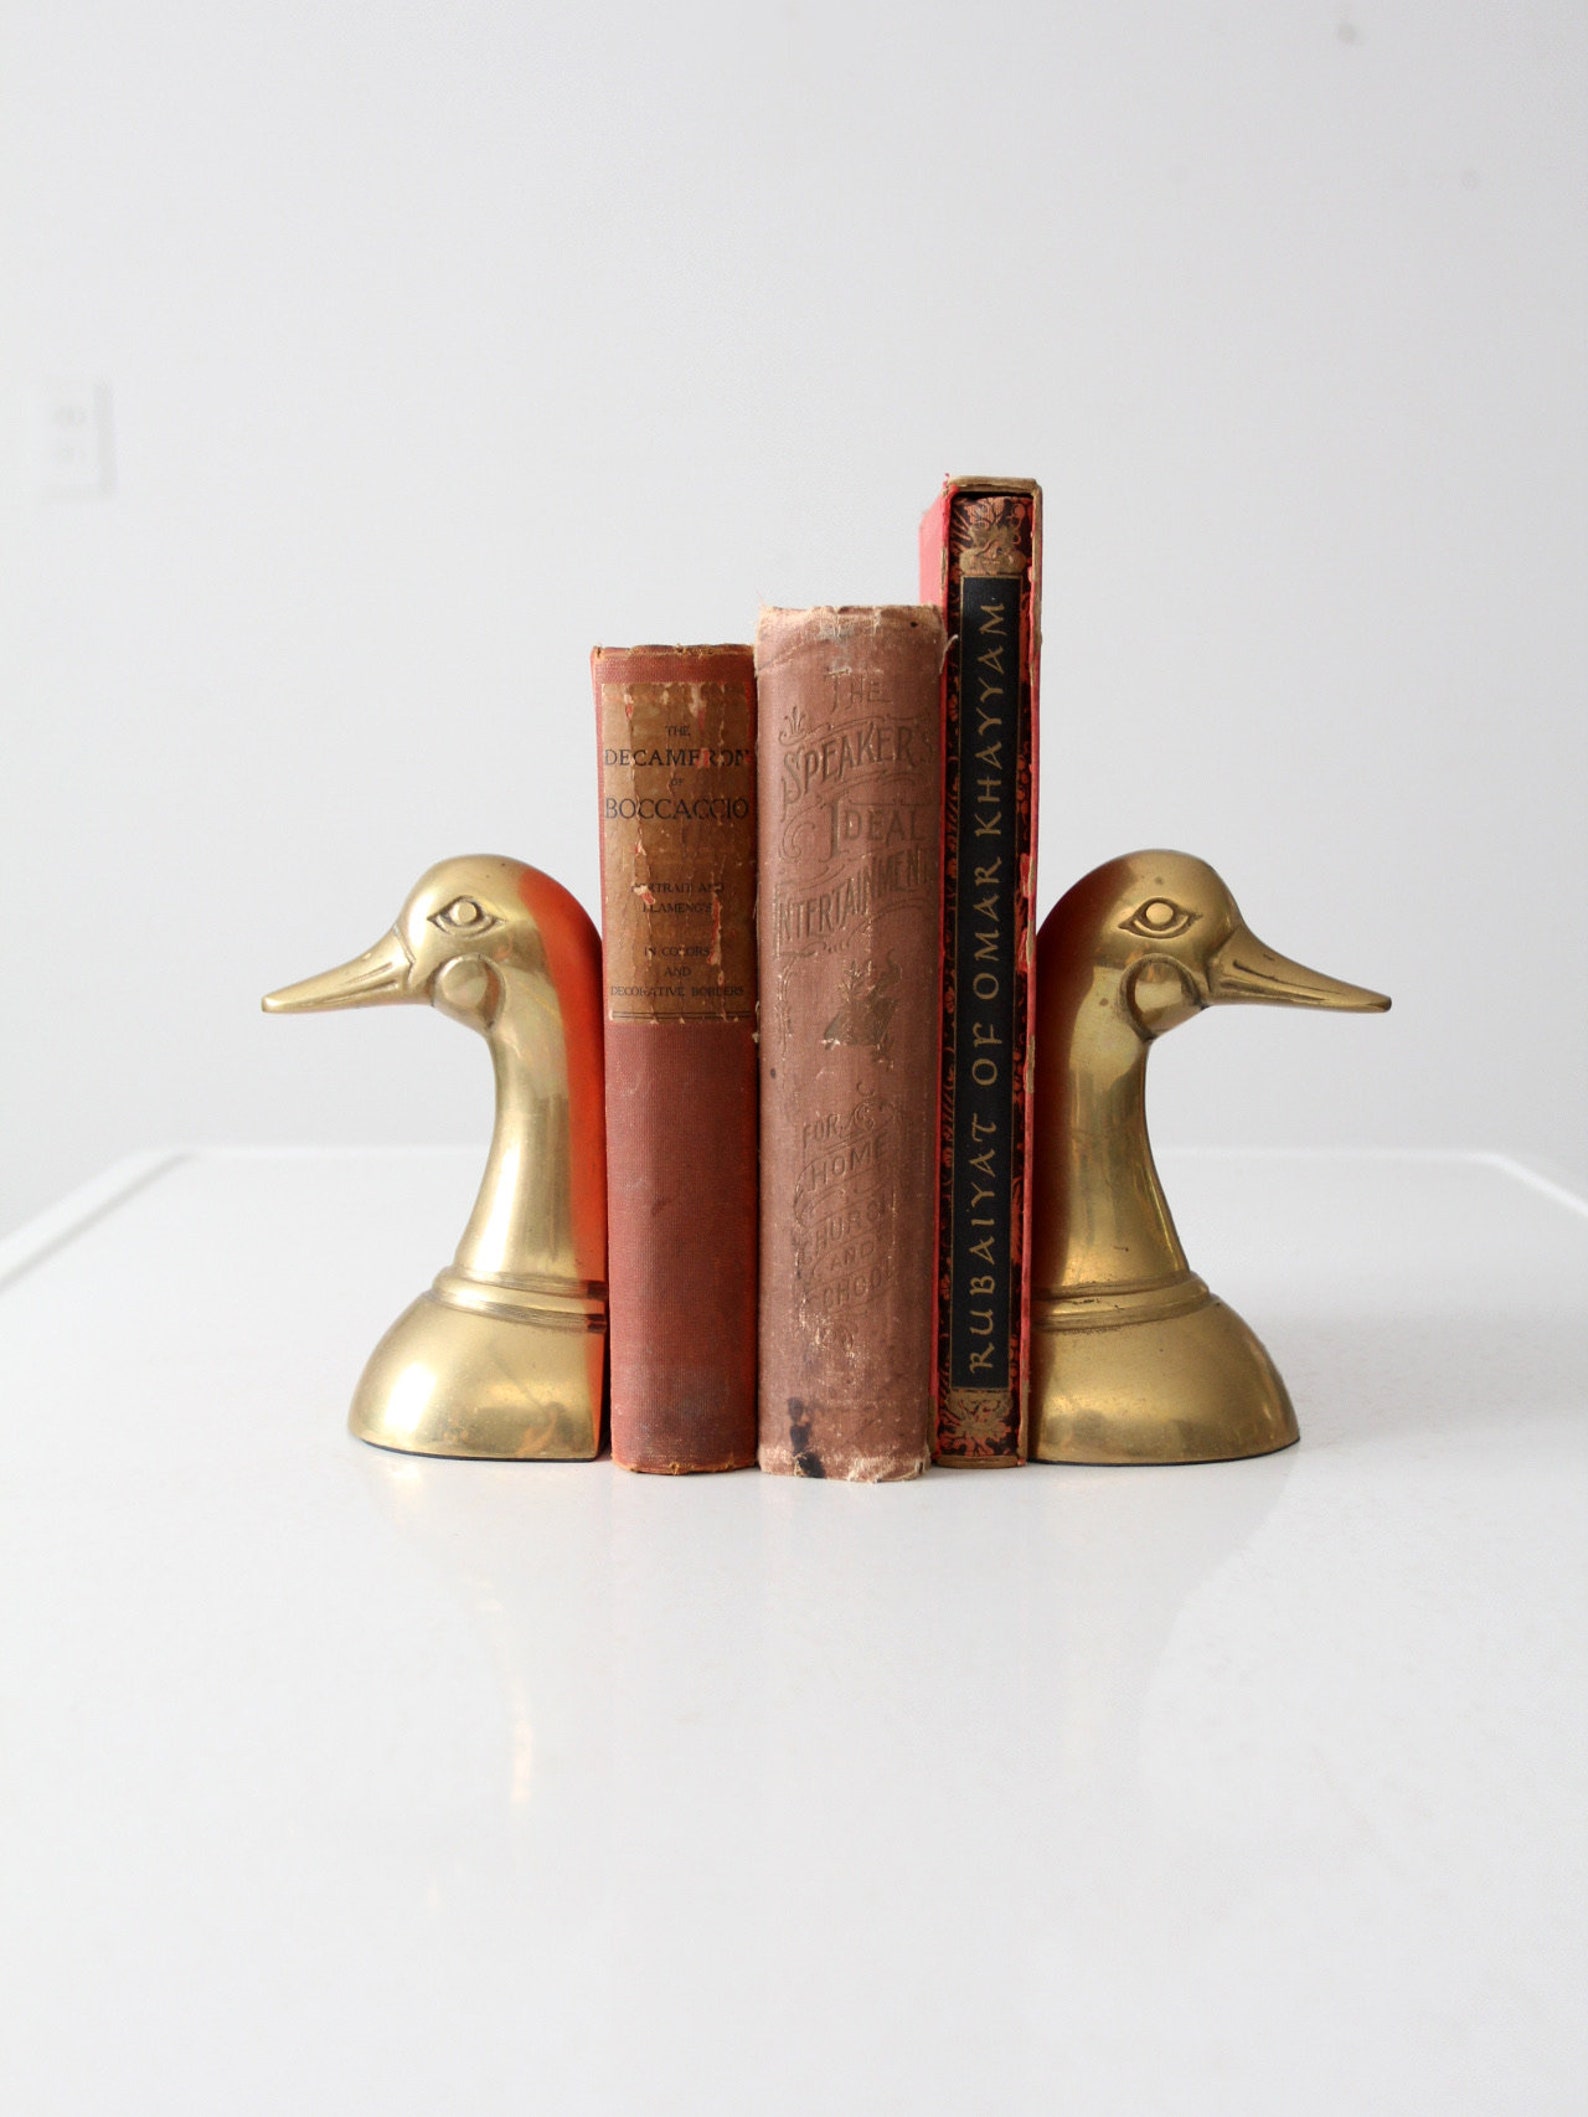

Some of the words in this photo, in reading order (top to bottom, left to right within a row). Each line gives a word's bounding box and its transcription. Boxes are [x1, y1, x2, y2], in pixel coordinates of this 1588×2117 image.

[824, 670, 892, 714] THE
[973, 601, 1007, 837] KHAYYAM
[665, 725, 691, 736] THE
[605, 797, 749, 819] BOCCACCIO
[972, 859, 1002, 1000] OMAR
[664, 966, 692, 977] AND
[971, 1022, 1003, 1087] OF
[968, 1111, 997, 1373] RUBAIYAT
